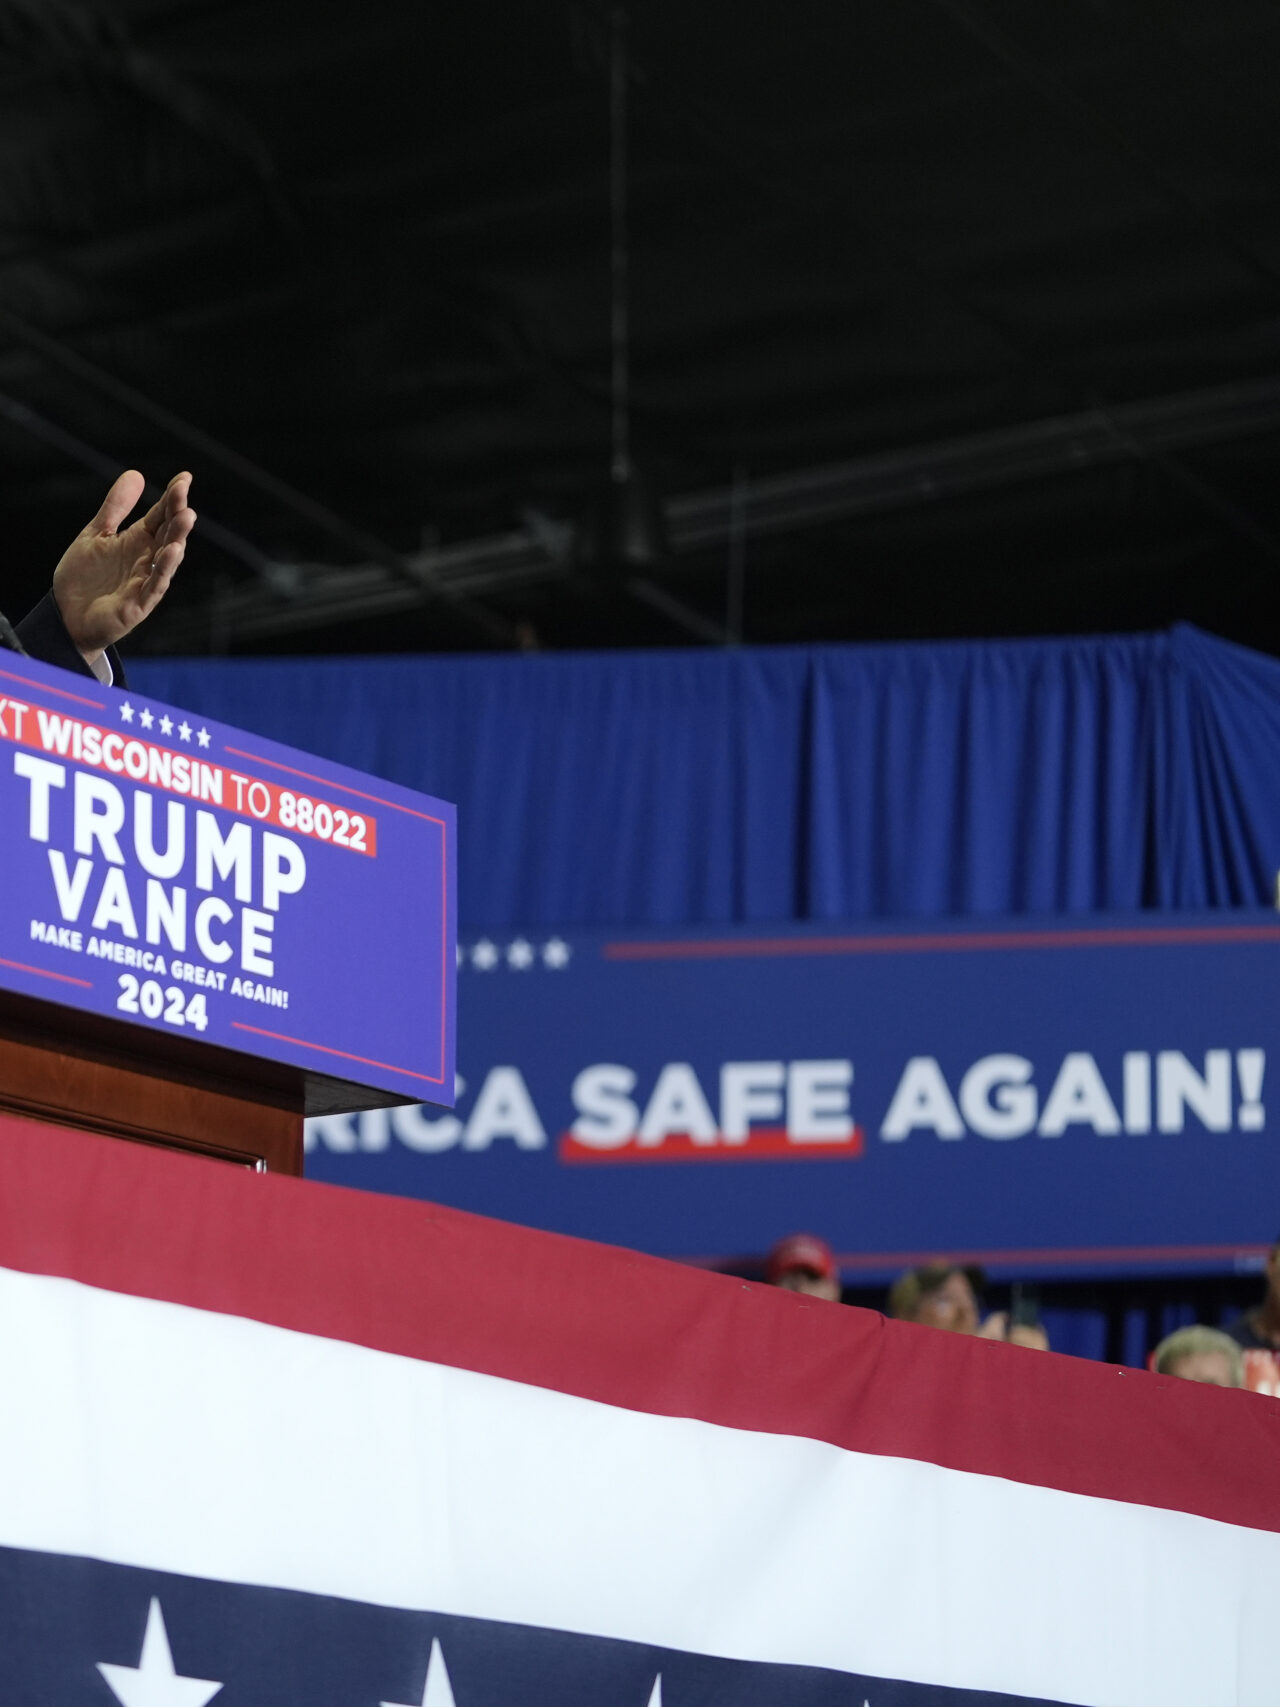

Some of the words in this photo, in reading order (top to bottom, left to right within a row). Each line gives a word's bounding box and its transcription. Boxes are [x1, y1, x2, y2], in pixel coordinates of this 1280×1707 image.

[14, 751, 307, 911] TRUMP
[37, 711, 223, 804] WISCONSIN
[231, 774, 270, 818] TO
[278, 792, 368, 851] 88022
[30, 920, 82, 952] MAKE
[86, 937, 167, 975] AMERICA
[171, 960, 227, 991] GREAT
[230, 974, 289, 1009] AGAIN!
[47, 849, 275, 977] VANCE
[117, 974, 208, 1031] 2024
[570, 1060, 854, 1150] SAFE
[880, 1049, 1265, 1141] AGAIN!
